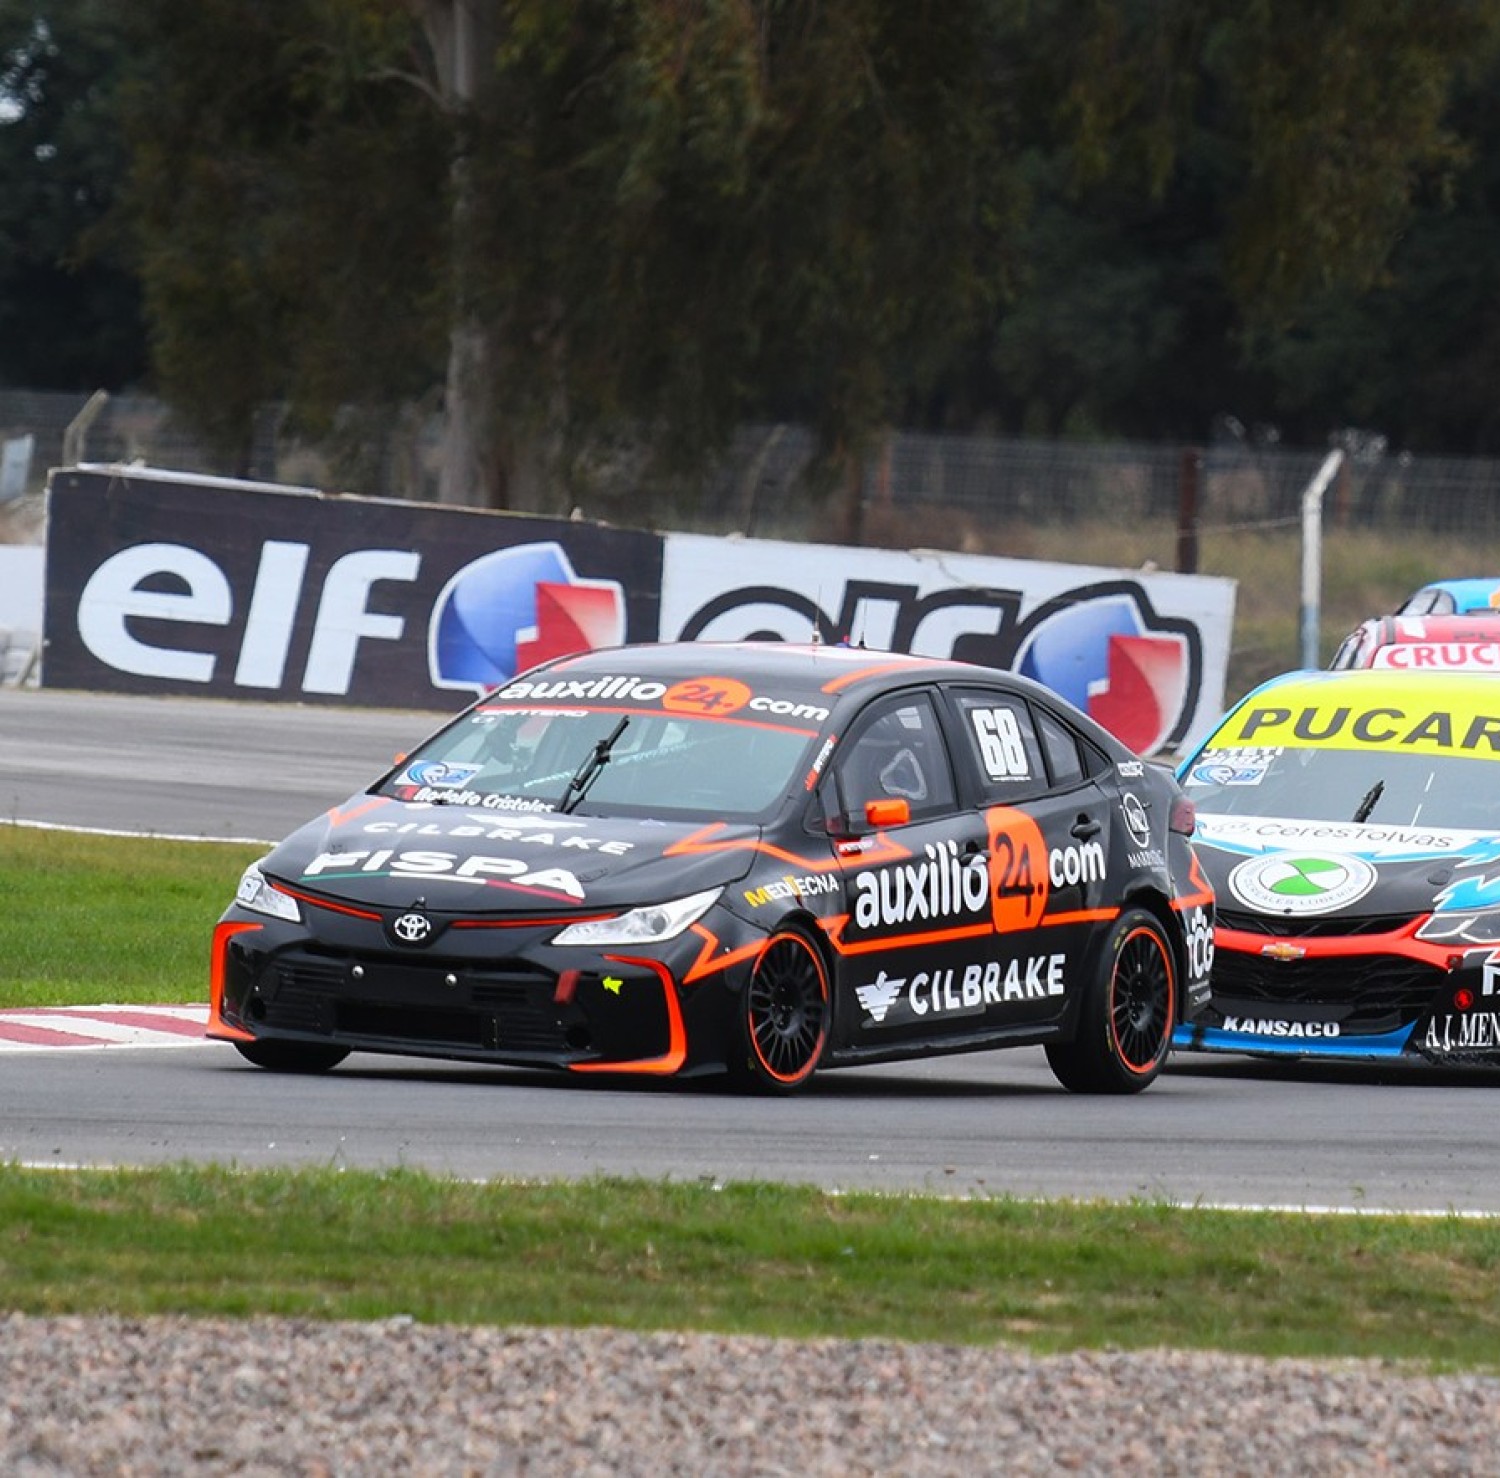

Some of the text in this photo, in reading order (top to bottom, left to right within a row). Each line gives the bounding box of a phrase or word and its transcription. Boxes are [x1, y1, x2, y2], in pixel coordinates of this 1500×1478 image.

[77, 540, 422, 695] elf
[499, 676, 667, 701] auxilio
[971, 709, 1029, 777] 68
[363, 821, 635, 857] CILBRAKE
[303, 849, 586, 899] FISPA
[855, 839, 989, 929] auxilio
[1049, 841, 1106, 889] com
[909, 953, 1067, 1015] CILBRAKE
[1222, 1016, 1340, 1038] KANSACO
